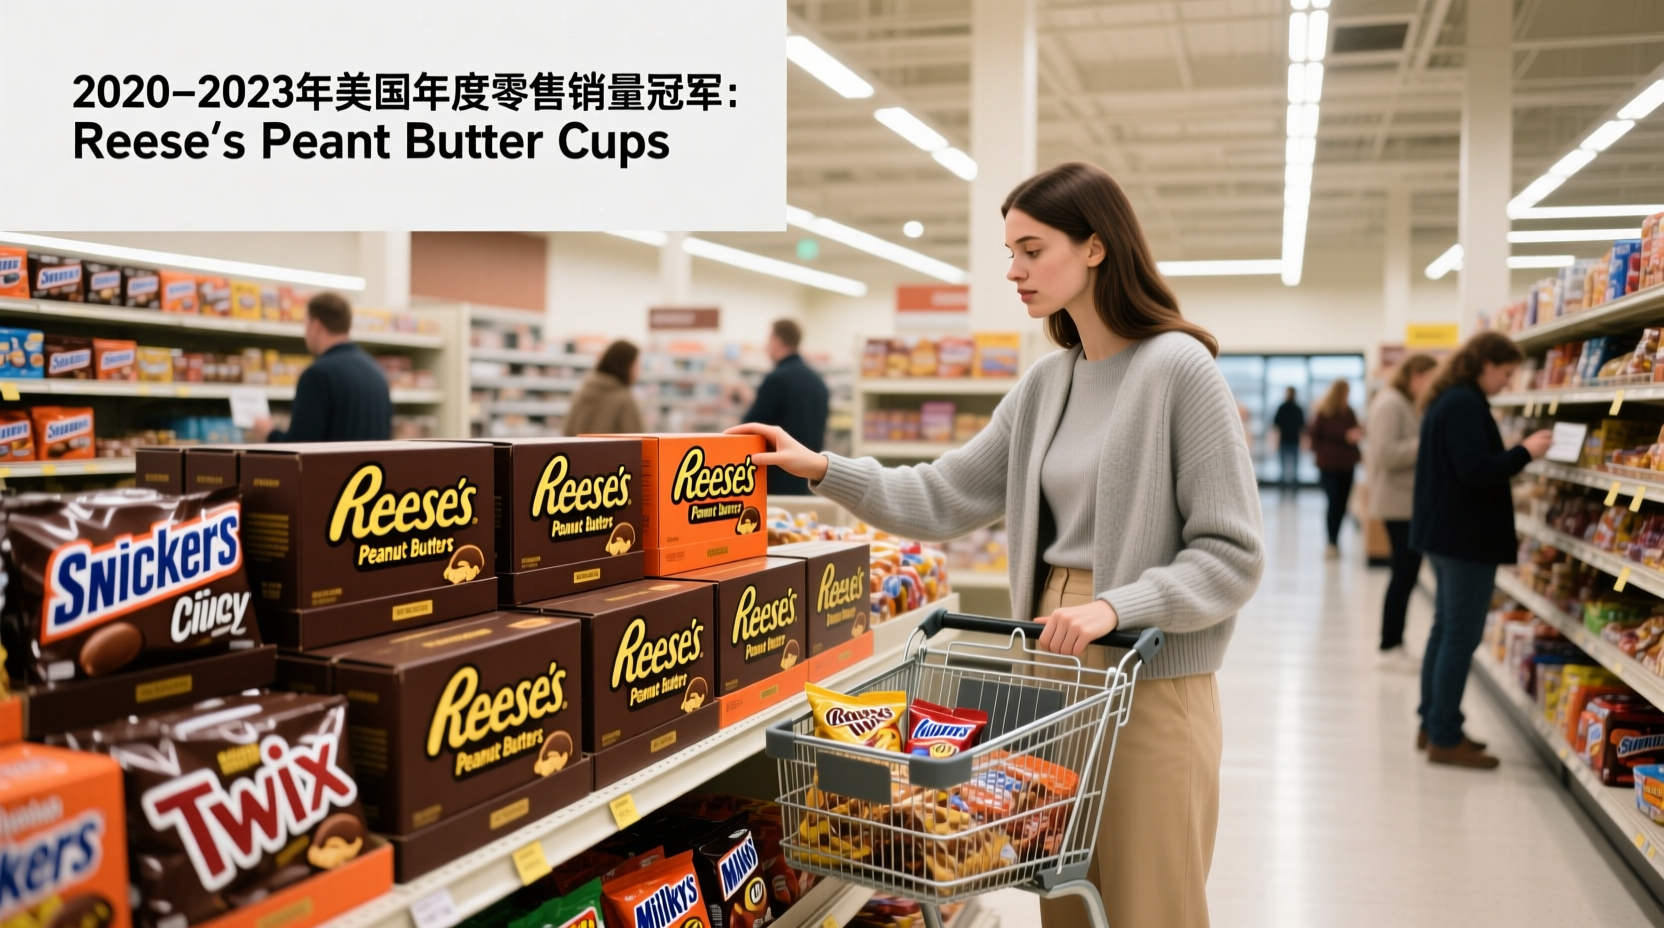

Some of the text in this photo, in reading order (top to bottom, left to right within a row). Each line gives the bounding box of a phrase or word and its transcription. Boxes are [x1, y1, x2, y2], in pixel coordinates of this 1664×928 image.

[329, 465, 477, 542] Reese's
[532, 455, 631, 517] Reese's
[673, 449, 756, 501] Reese's
[54, 515, 238, 627] Snickers
[358, 542, 408, 566] Peanut
[732, 586, 797, 644] Reese's
[612, 618, 704, 689] Reese's
[427, 662, 566, 756] Reese's
[154, 743, 350, 878] Twix
